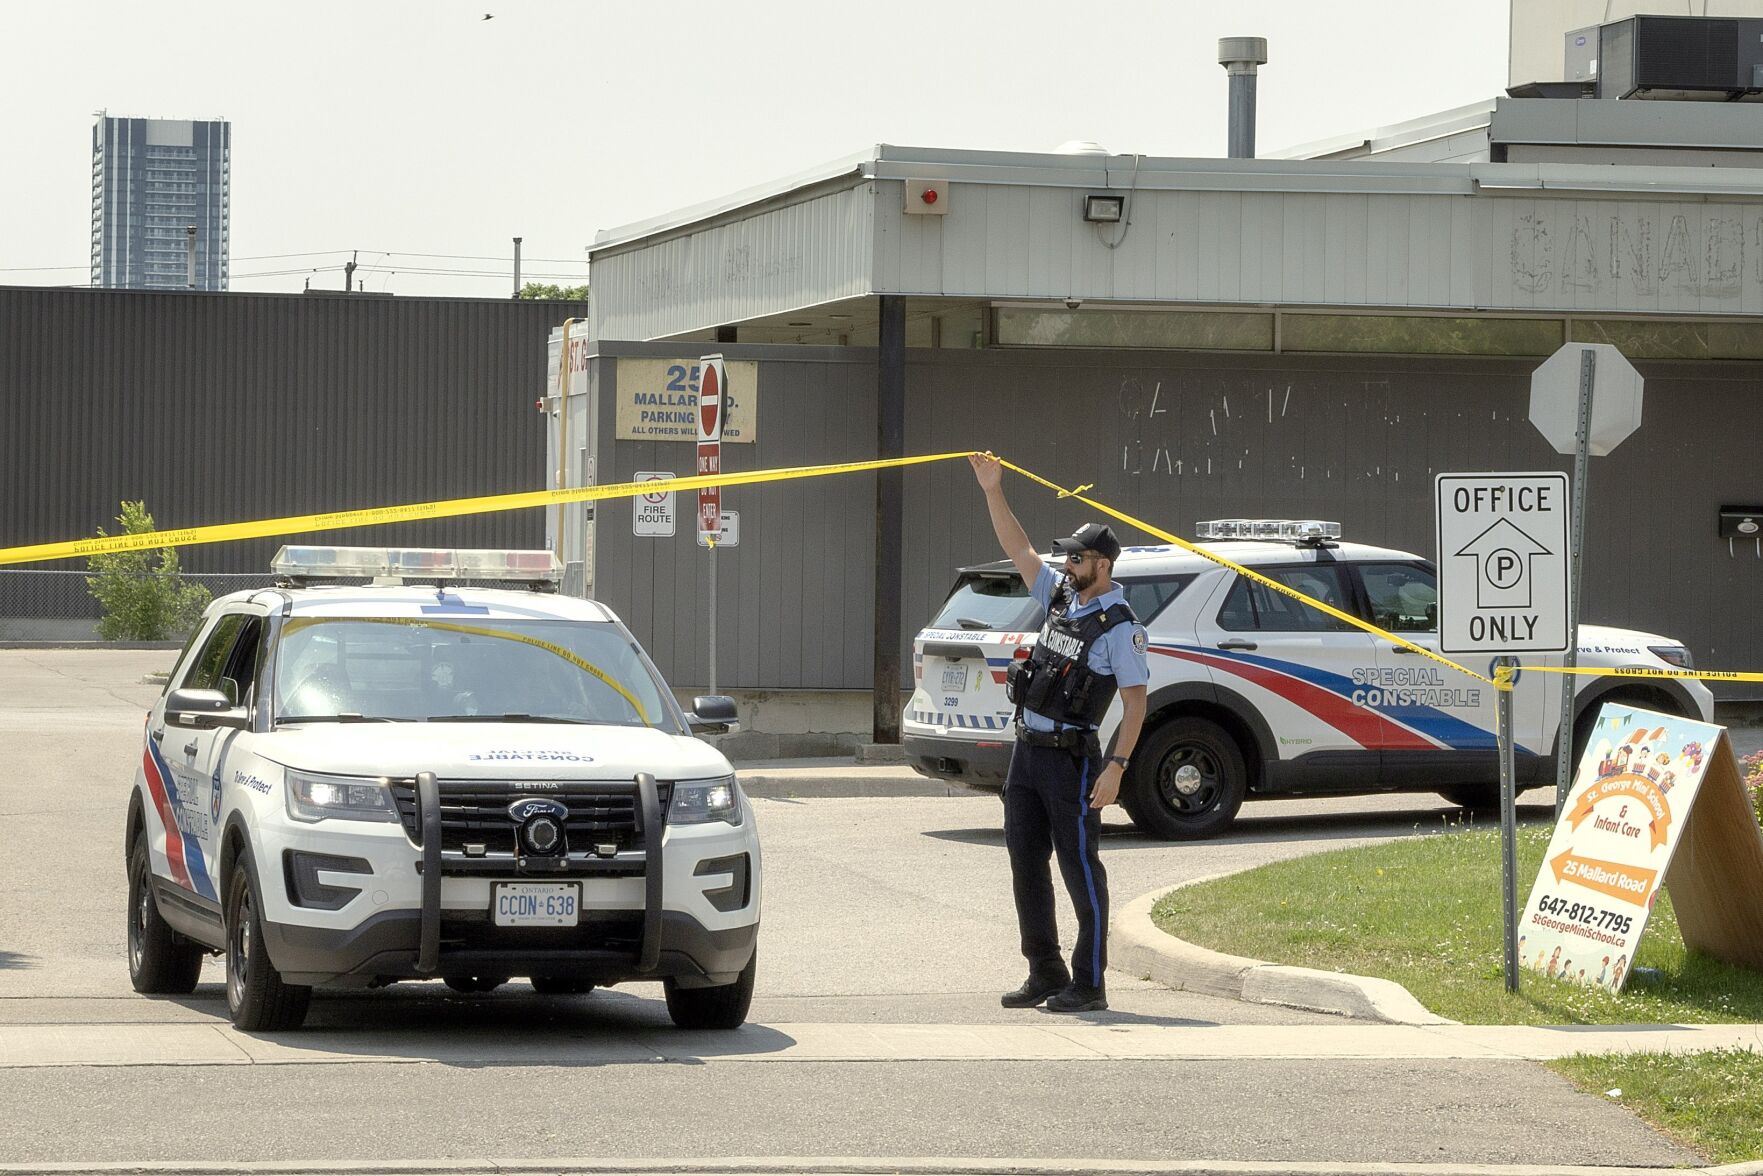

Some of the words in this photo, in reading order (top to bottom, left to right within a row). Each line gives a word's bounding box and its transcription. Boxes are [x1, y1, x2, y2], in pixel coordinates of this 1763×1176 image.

[1510, 213, 1763, 288] CANAD
[667, 365, 700, 392] 25
[634, 393, 697, 406] MALLAR
[641, 411, 695, 423] PARKING
[632, 426, 646, 434] ALL
[648, 427, 679, 435] OTHERS
[1454, 487, 1552, 512] OFFICE
[638, 515, 672, 523] ROUTE
[644, 506, 666, 514] FIRE
[702, 503, 716, 519] ENTER
[1497, 556, 1514, 581] P
[1469, 615, 1539, 642] ONLY
[1604, 646, 1641, 654] Protect
[1352, 667, 1444, 686] SPECIAL
[944, 697, 959, 707] 3299
[1351, 689, 1480, 707] CONSTABLE
[248, 776, 273, 795] Protect
[1600, 780, 1632, 794] George
[1632, 780, 1650, 795] Mini
[1646, 789, 1666, 820] School
[1619, 805, 1627, 818] &
[1594, 815, 1620, 833] Infant
[1621, 822, 1641, 838] Care
[1562, 860, 1578, 875] 25
[1576, 863, 1618, 886] Mallard
[1616, 874, 1648, 894] Road
[500, 895, 537, 915] CCDN
[546, 896, 575, 915] 638
[1538, 895, 1633, 934] 647-812-7795
[1531, 913, 1626, 948] StGeorgeMiniSchool.ca
